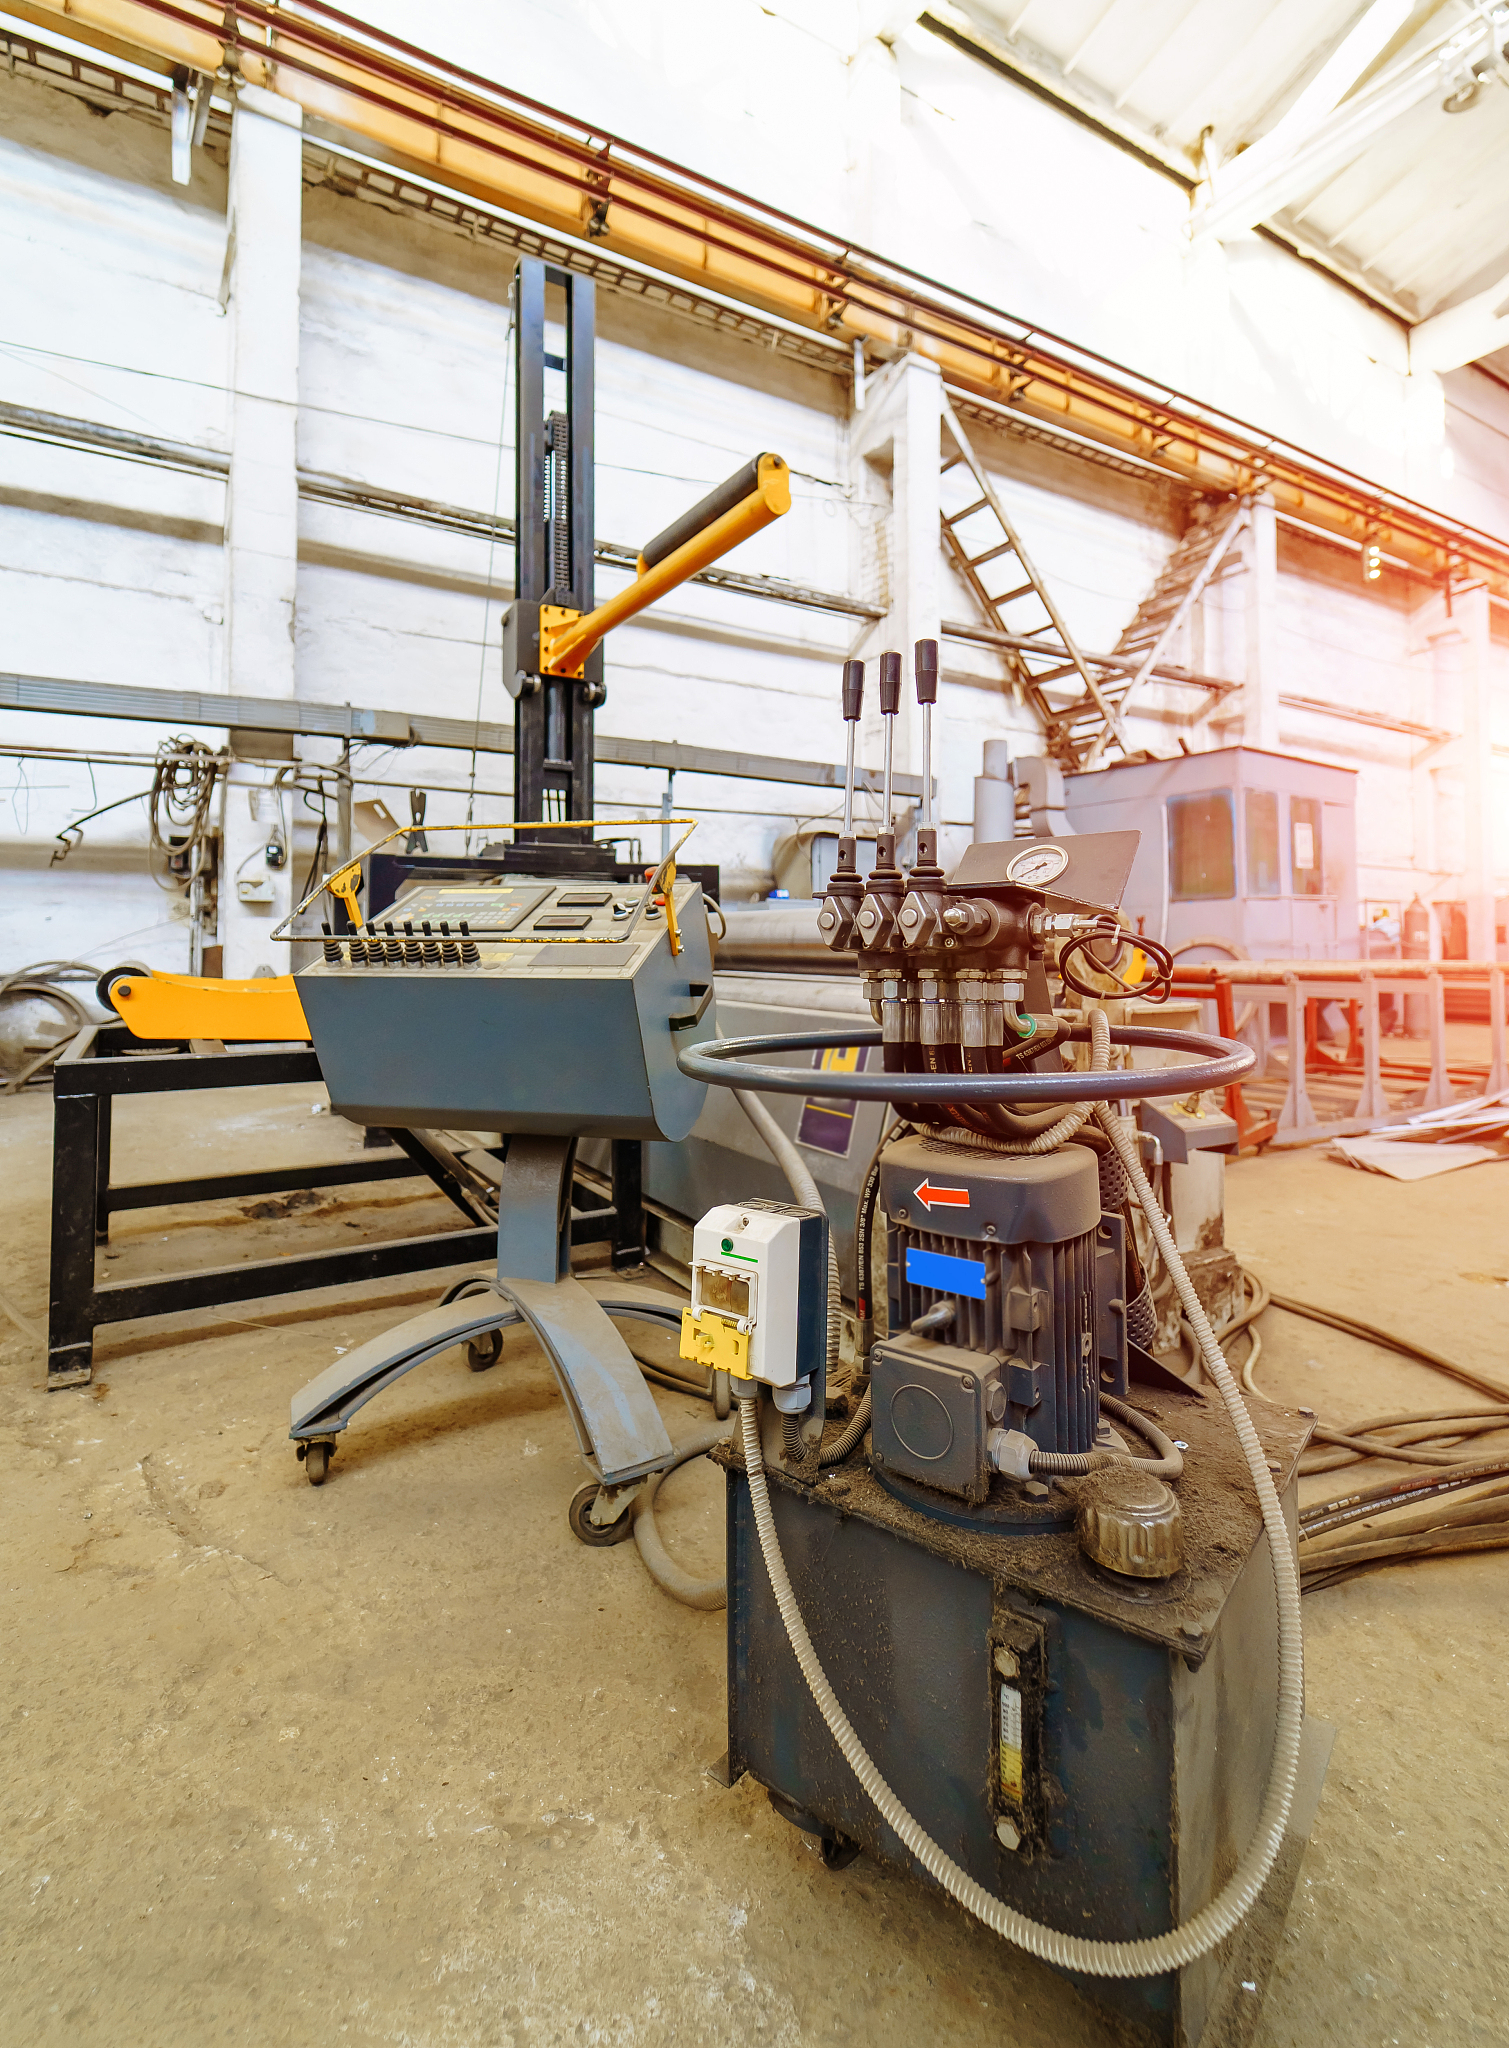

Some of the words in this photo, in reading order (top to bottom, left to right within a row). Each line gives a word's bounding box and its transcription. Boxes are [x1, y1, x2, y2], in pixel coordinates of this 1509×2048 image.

[871, 1165, 879, 1176] Bar
[867, 1176, 875, 1188] 330
[864, 1187, 871, 1199] WP
[861, 1200, 869, 1214] Max.
[859, 1282, 865, 1291] TS
